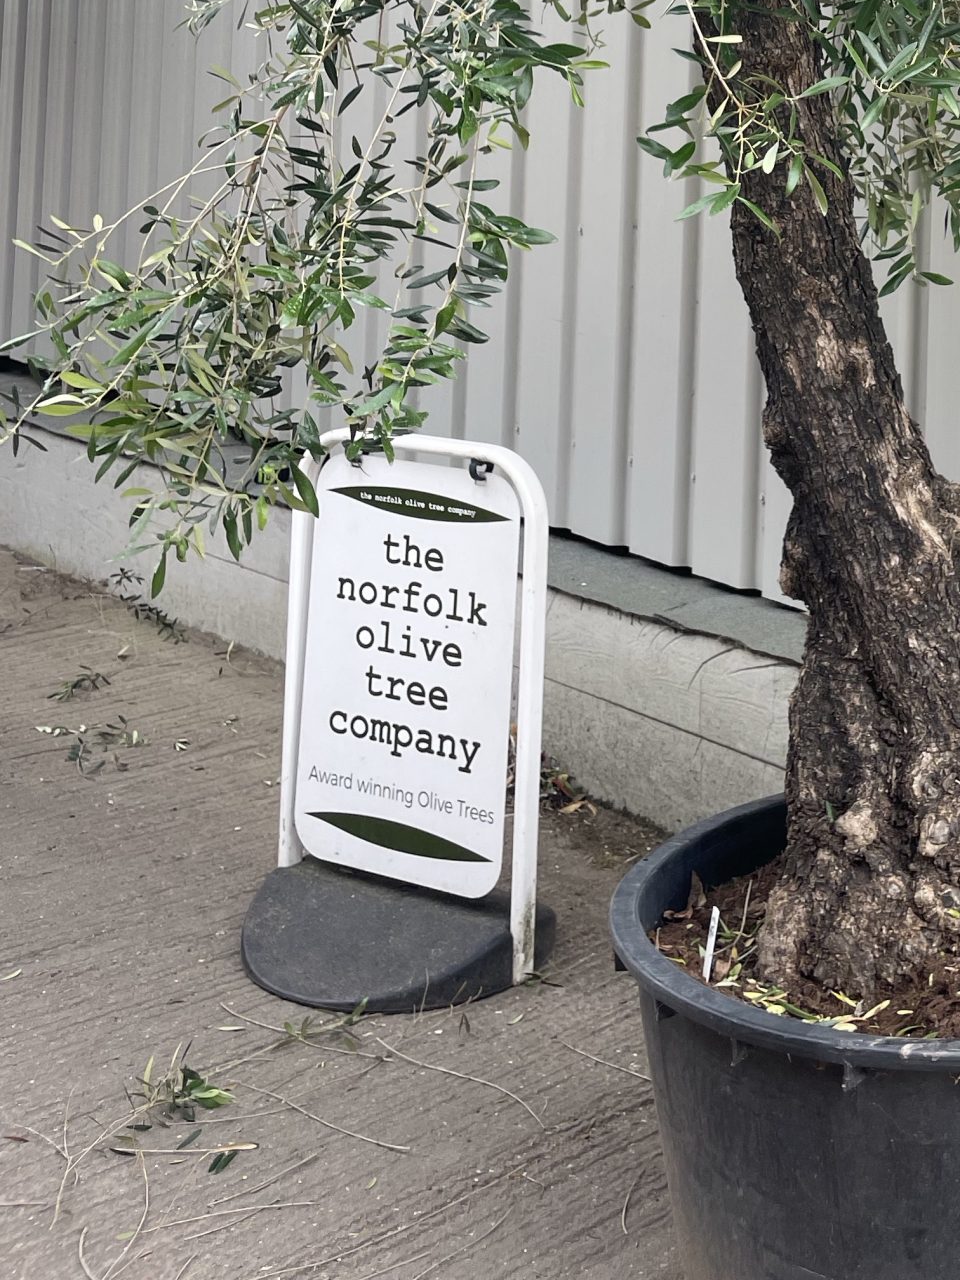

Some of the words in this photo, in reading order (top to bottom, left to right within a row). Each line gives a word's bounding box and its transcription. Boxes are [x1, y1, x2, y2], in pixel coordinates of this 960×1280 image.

[360, 491, 373, 500] the
[375, 494, 403, 505] norfolk
[405, 498, 426, 509] olive
[428, 502, 445, 512] tree
[447, 506, 477, 519] company
[383, 533, 444, 572] the
[336, 576, 488, 627] norfolk
[356, 620, 463, 667] olive
[365, 665, 448, 711] tree
[329, 710, 481, 774] company
[308, 765, 353, 790] Award
[357, 777, 414, 808] winning
[417, 790, 453, 815] Olive
[457, 799, 494, 825] Trees
